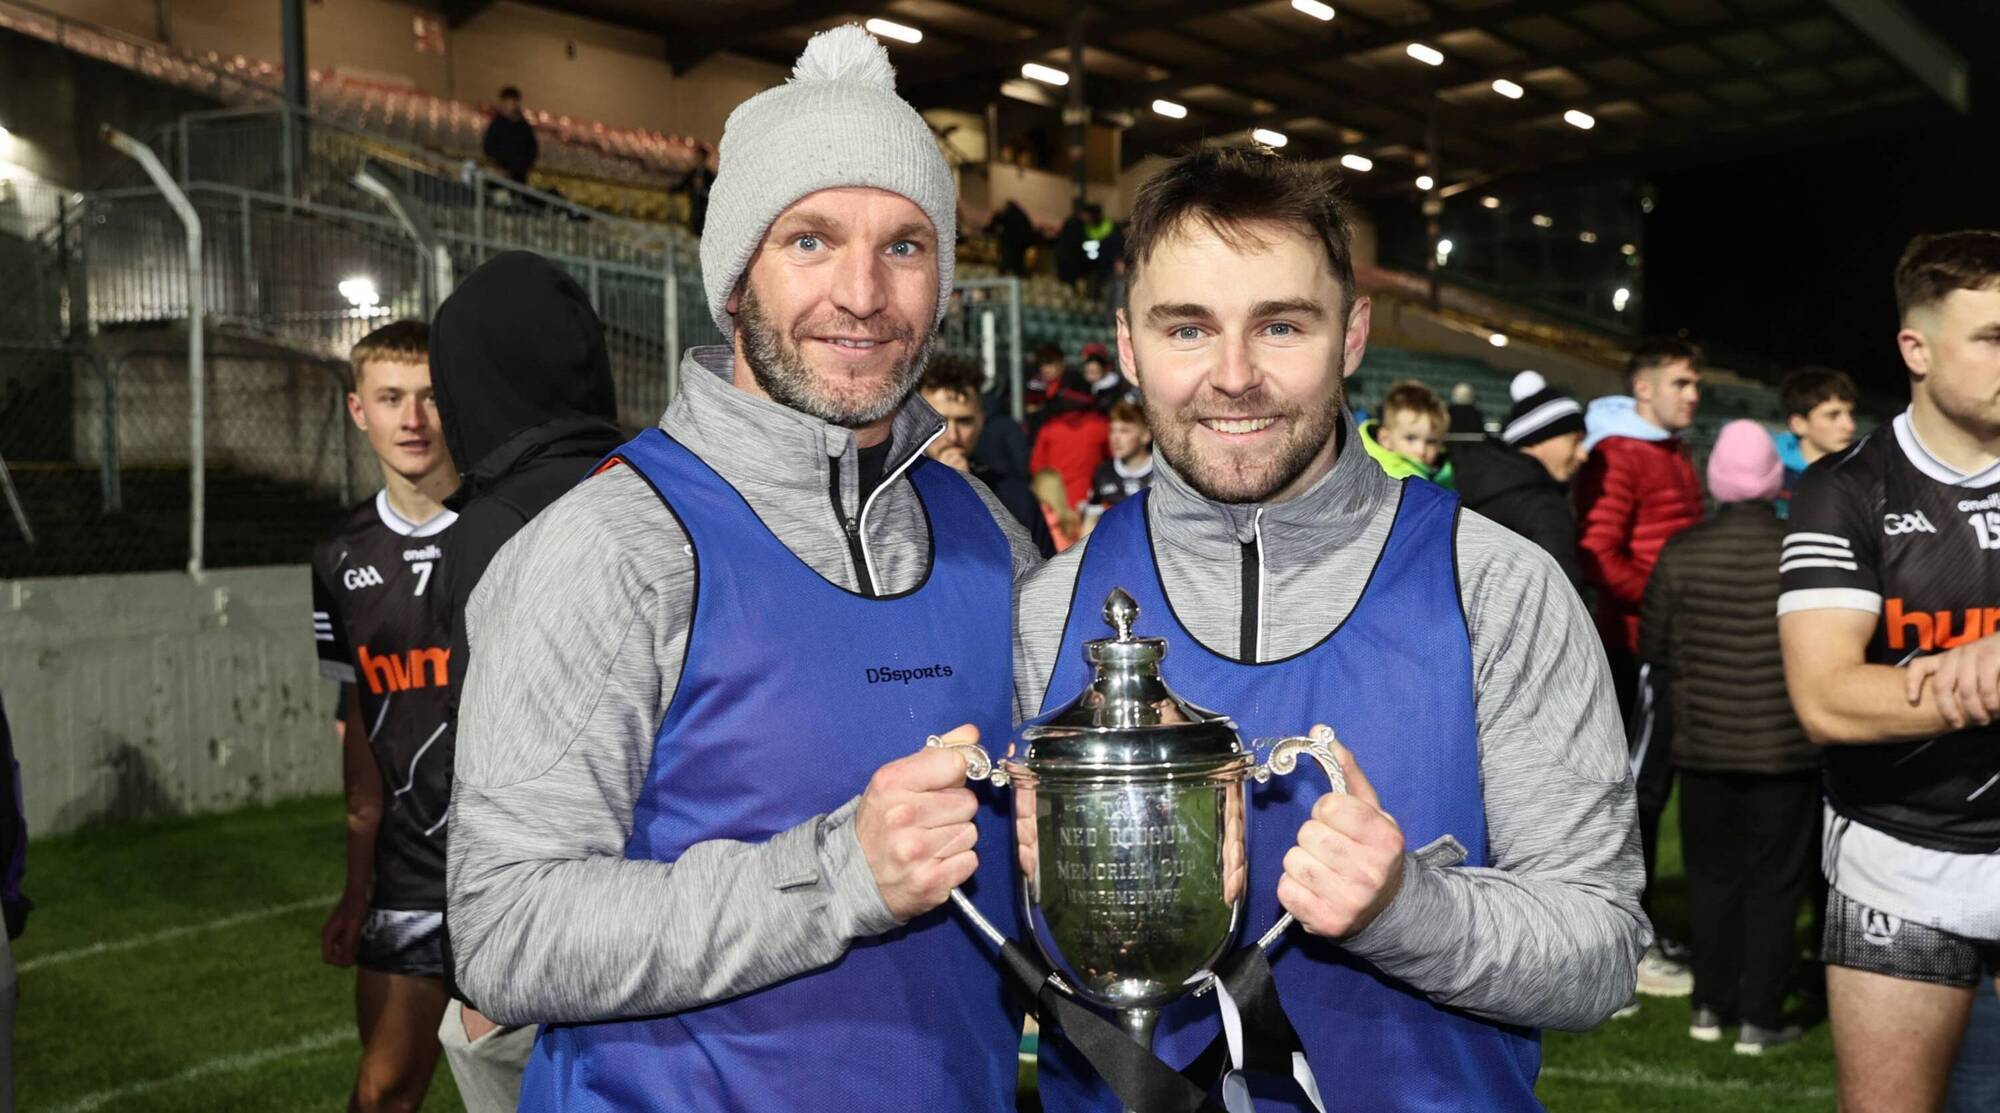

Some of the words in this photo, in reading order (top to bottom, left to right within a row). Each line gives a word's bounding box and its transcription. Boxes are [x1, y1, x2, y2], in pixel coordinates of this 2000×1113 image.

[1957, 494, 2000, 512] oneill
[1968, 512, 2000, 549] 15
[412, 562, 433, 596] 7
[865, 664, 953, 684] DSsports
[1060, 827, 1097, 847] NED
